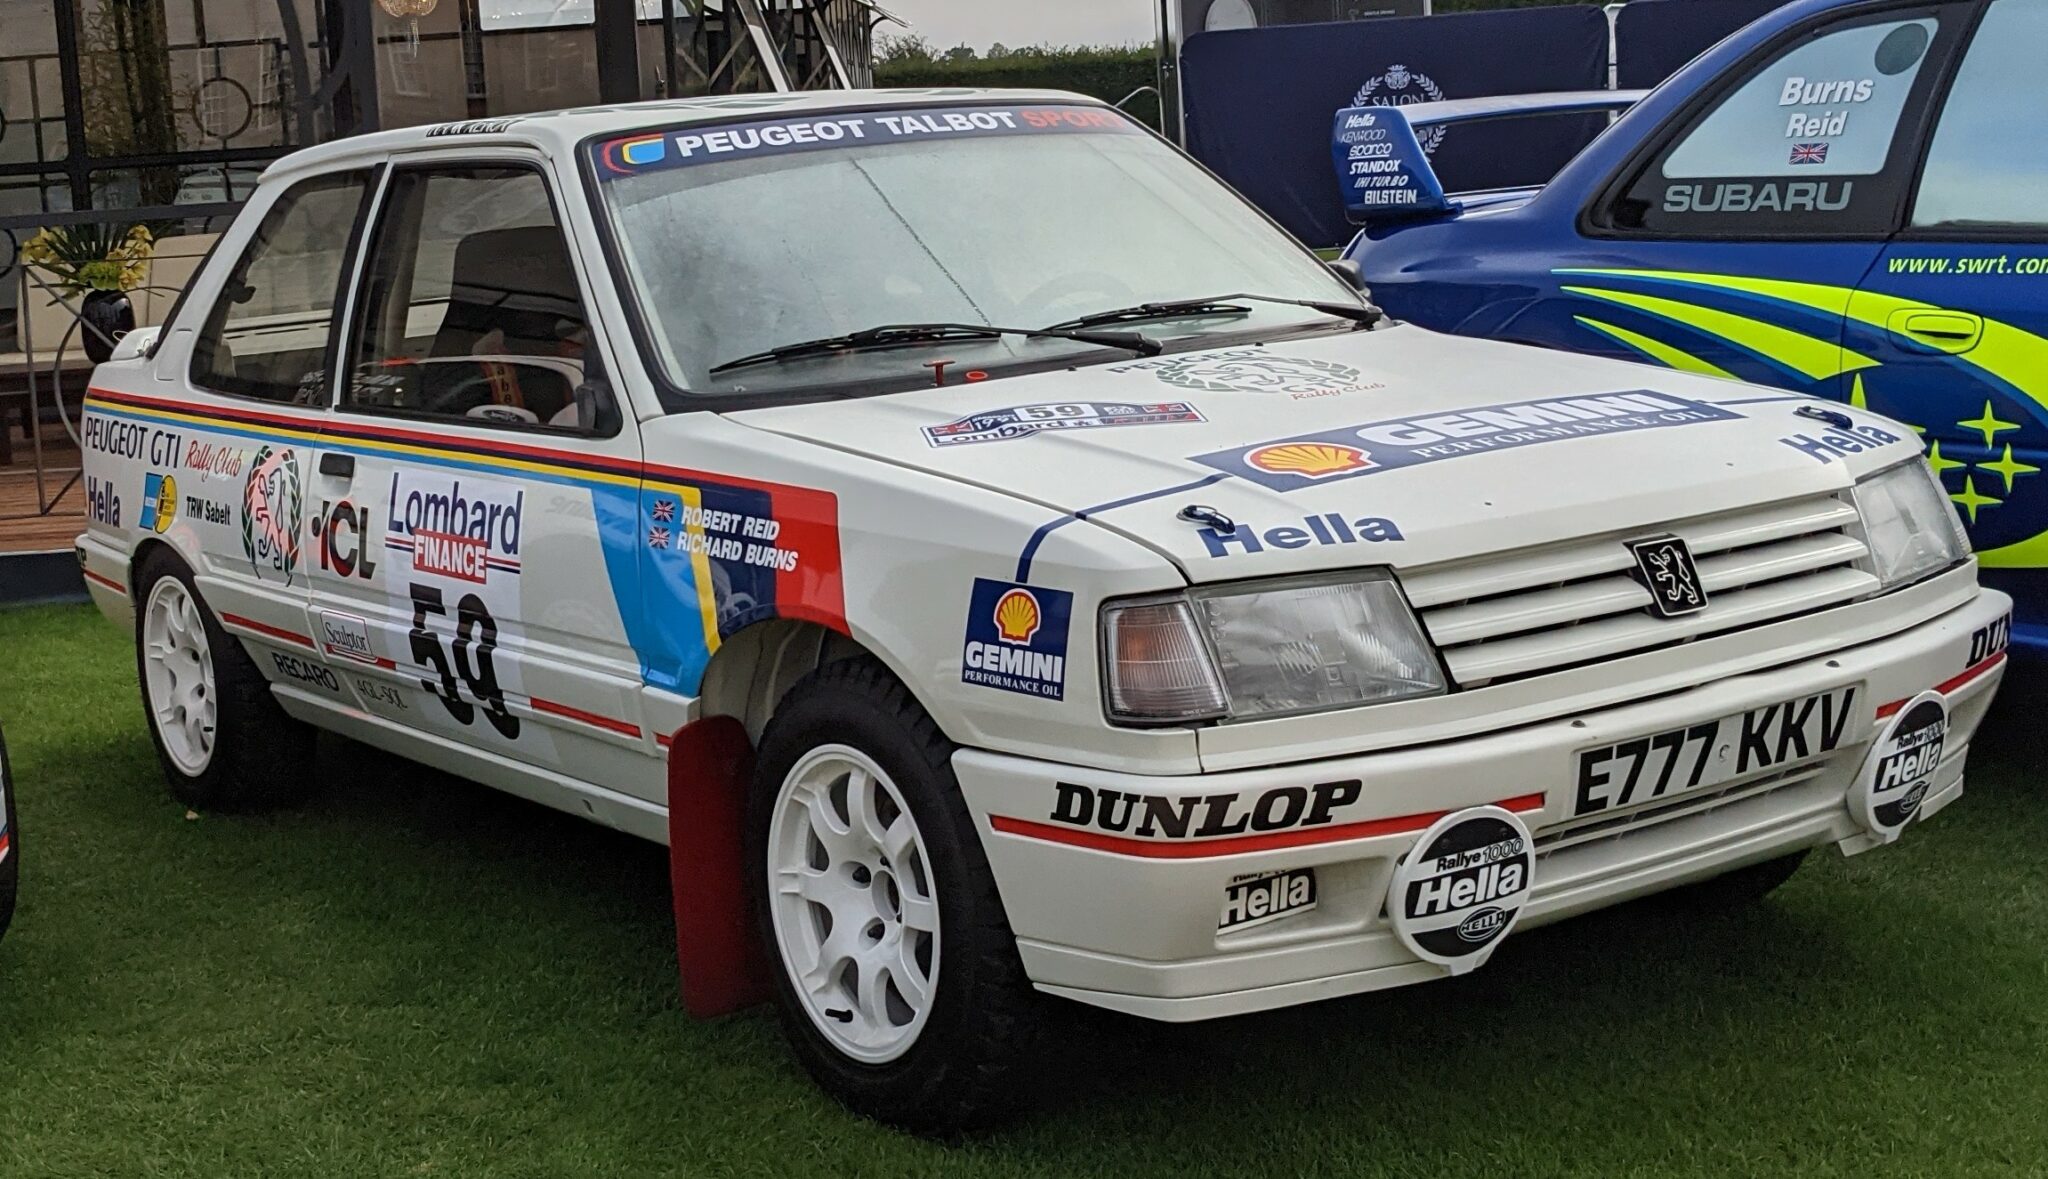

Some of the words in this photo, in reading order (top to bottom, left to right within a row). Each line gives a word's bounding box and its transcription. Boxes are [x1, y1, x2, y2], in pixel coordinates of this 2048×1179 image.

[1778, 77, 1875, 106] Burns
[676, 119, 865, 157] PEUGEOT
[875, 111, 1018, 136] TALBOT
[1020, 110, 1126, 128] SPORT
[1340, 129, 1386, 144] KENWOOD
[1345, 113, 1376, 129] Hella
[1785, 111, 1848, 138] Reid
[1349, 143, 1393, 158] sparco
[1349, 159, 1402, 175] STANDOX
[1364, 189, 1417, 204] BILSTEIN
[1663, 182, 1853, 212] SUBARU
[1107, 350, 1271, 374] PEUGEOT
[1022, 404, 1085, 418] 59
[1290, 388, 1341, 400] Rally
[1343, 383, 1386, 393] Club
[933, 420, 1066, 444] Lombard
[1356, 393, 1690, 446] GEMINI
[1410, 417, 1658, 458] PERFORMANCE
[1659, 410, 1720, 422] OIL
[85, 416, 148, 461] PEUGEOT
[150, 429, 181, 469] GTI
[184, 440, 215, 481] Rally
[214, 447, 242, 478] Club
[1778, 426, 1901, 464] Hella
[88, 476, 121, 529] Hella
[186, 496, 203, 520] TRW
[204, 498, 231, 526] Sabelt
[388, 472, 524, 555] Lombard
[681, 505, 743, 535] ROBERT
[742, 518, 781, 541] REID
[1197, 513, 1405, 558] Hella
[414, 535, 486, 579] FINANCE
[676, 531, 743, 562] RICHARD
[744, 545, 799, 572] BURNS
[272, 652, 340, 692] RECARO
[408, 582, 520, 740] 59
[965, 641, 1063, 683] GEMINI
[964, 669, 1039, 693] PERFORMANCE
[1042, 684, 1060, 697] OIL
[1575, 720, 1720, 816] E777
[1736, 687, 1856, 775] KKV
[1880, 742, 1940, 789] Hella
[1050, 778, 1362, 839] DUNLOP
[1436, 852, 1480, 873] Rallye
[1482, 837, 1524, 863] 1000
[1219, 874, 1310, 926] Hella
[1414, 863, 1523, 916] Hella
[1460, 909, 1506, 931] HELLA
